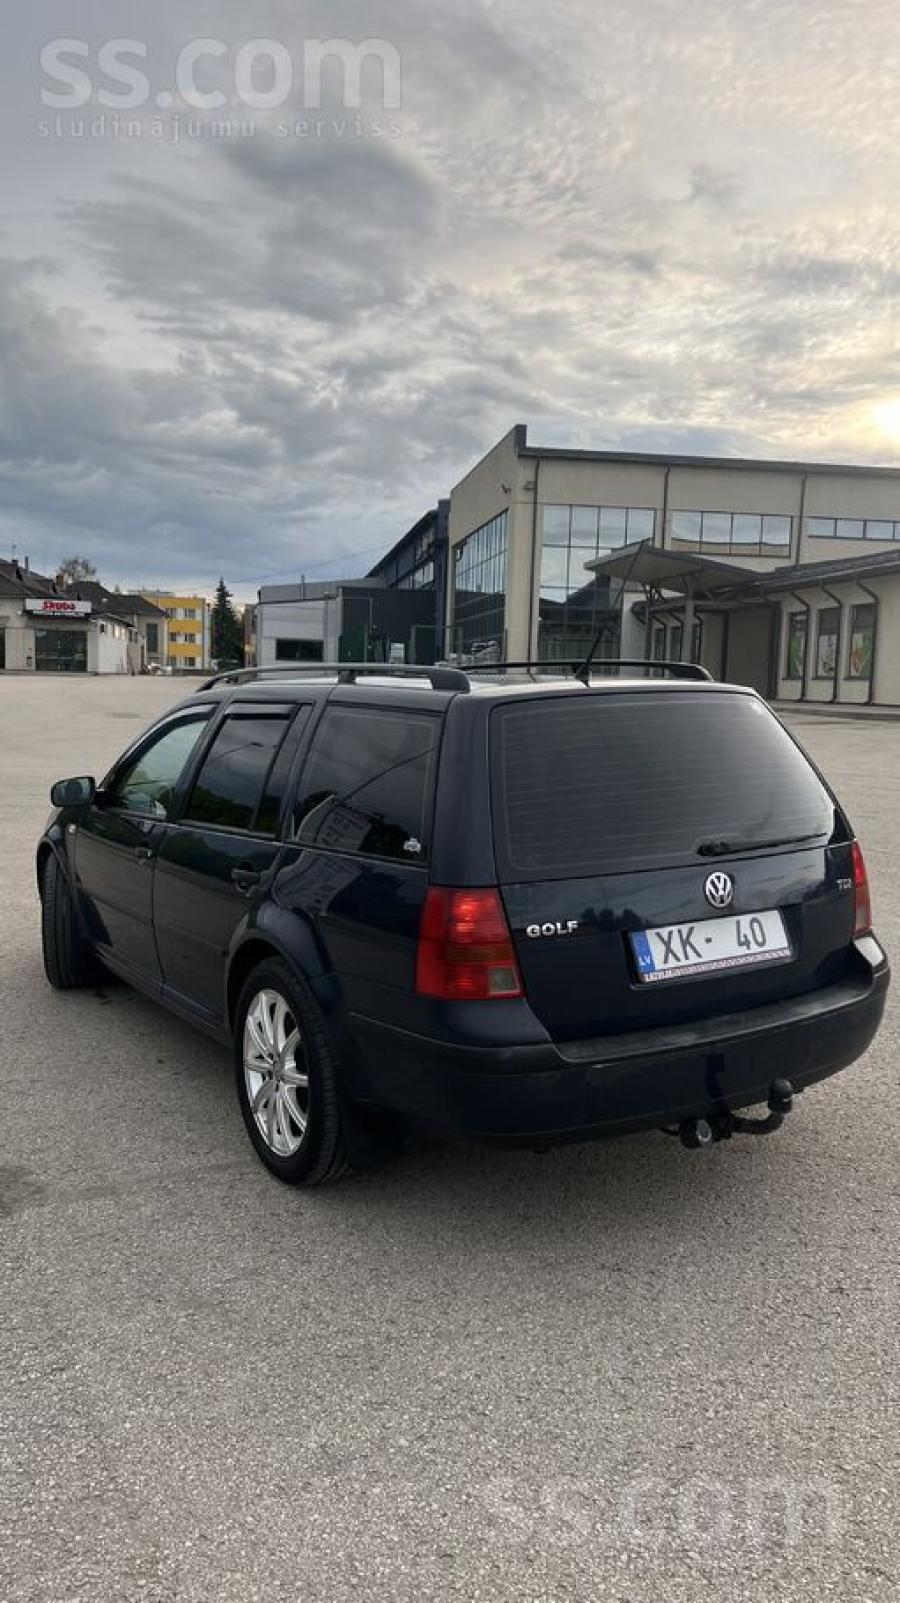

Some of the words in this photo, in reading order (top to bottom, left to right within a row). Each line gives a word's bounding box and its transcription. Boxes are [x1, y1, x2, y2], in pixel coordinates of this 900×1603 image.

[526, 920, 579, 938] GOLF
[735, 917, 767, 950] 40
[640, 954, 651, 967] LV
